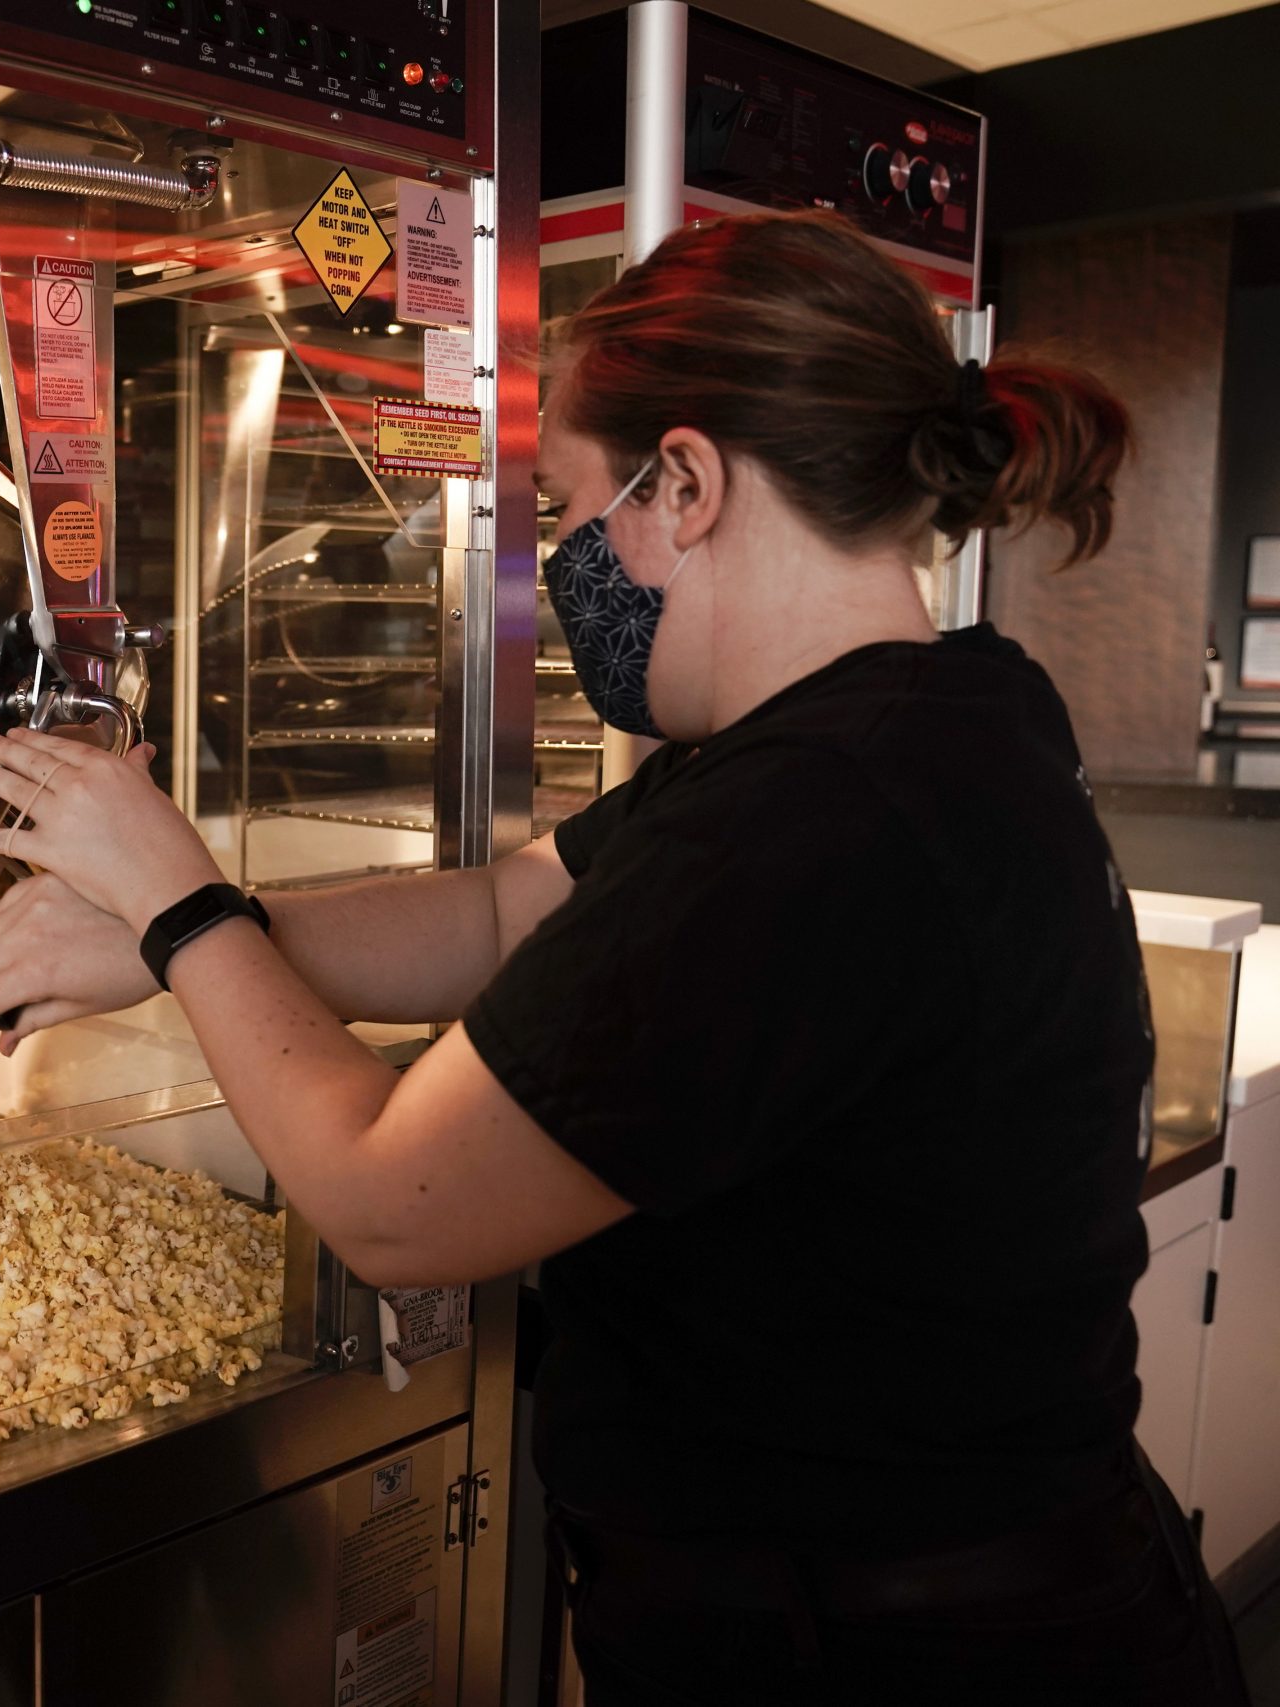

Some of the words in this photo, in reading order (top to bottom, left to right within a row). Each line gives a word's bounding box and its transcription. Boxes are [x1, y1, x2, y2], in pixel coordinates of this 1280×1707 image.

[95, 12, 115, 23] SYSTEM
[115, 18, 133, 28] ARMED
[102, 7, 138, 22] SUPPRESSION
[144, 30, 160, 40] FILTER
[160, 35, 180, 45] SYSTEM
[200, 54, 216, 64] LIGHTS
[229, 62, 237, 70] OIL
[237, 64, 255, 74] SYSTEM
[255, 69, 274, 79] MASTER
[284, 77, 303, 87] WARMER
[319, 86, 334, 96] KETTLE
[334, 91, 350, 100] MOTOR
[360, 98, 375, 107] KETTLE
[400, 108, 421, 118] INDICATOR
[334, 186, 354, 201] KEEP
[321, 200, 349, 216] MOTOR
[351, 207, 366, 220] AND
[319, 216, 338, 230] HEAT
[340, 220, 370, 236] SWITCH
[407, 224, 437, 239] WARNING:
[324, 249, 346, 265] WHEN
[349, 254, 364, 267] NOT
[51, 262, 93, 276] CAUTION
[327, 266, 361, 283] POPPING
[407, 270, 462, 288] ADVERTISSEMENT:
[330, 283, 354, 298] CORN.
[381, 404, 414, 417] REMEMBER
[415, 408, 429, 418] SEED
[430, 410, 447, 420] FIRST,
[447, 411, 457, 421] OIL
[458, 412, 479, 423] SECOND
[381, 419, 386, 427] IF
[387, 420, 396, 428] THE
[397, 421, 416, 430] KETTLE
[417, 422, 423, 430] IS
[423, 423, 447, 433] SMOKING
[448, 425, 479, 435] EXCESSIVELY
[69, 440, 103, 450] CAUTION:
[65, 459, 107, 469] ATTENTION:
[383, 457, 406, 466] CONTACT
[407, 459, 443, 468] MANAGEMENT
[444, 462, 477, 471] IMMEDIATELY
[52, 533, 68, 541] ALWAYS
[376, 1469, 391, 1482] Big
[393, 1463, 407, 1475] Eye
